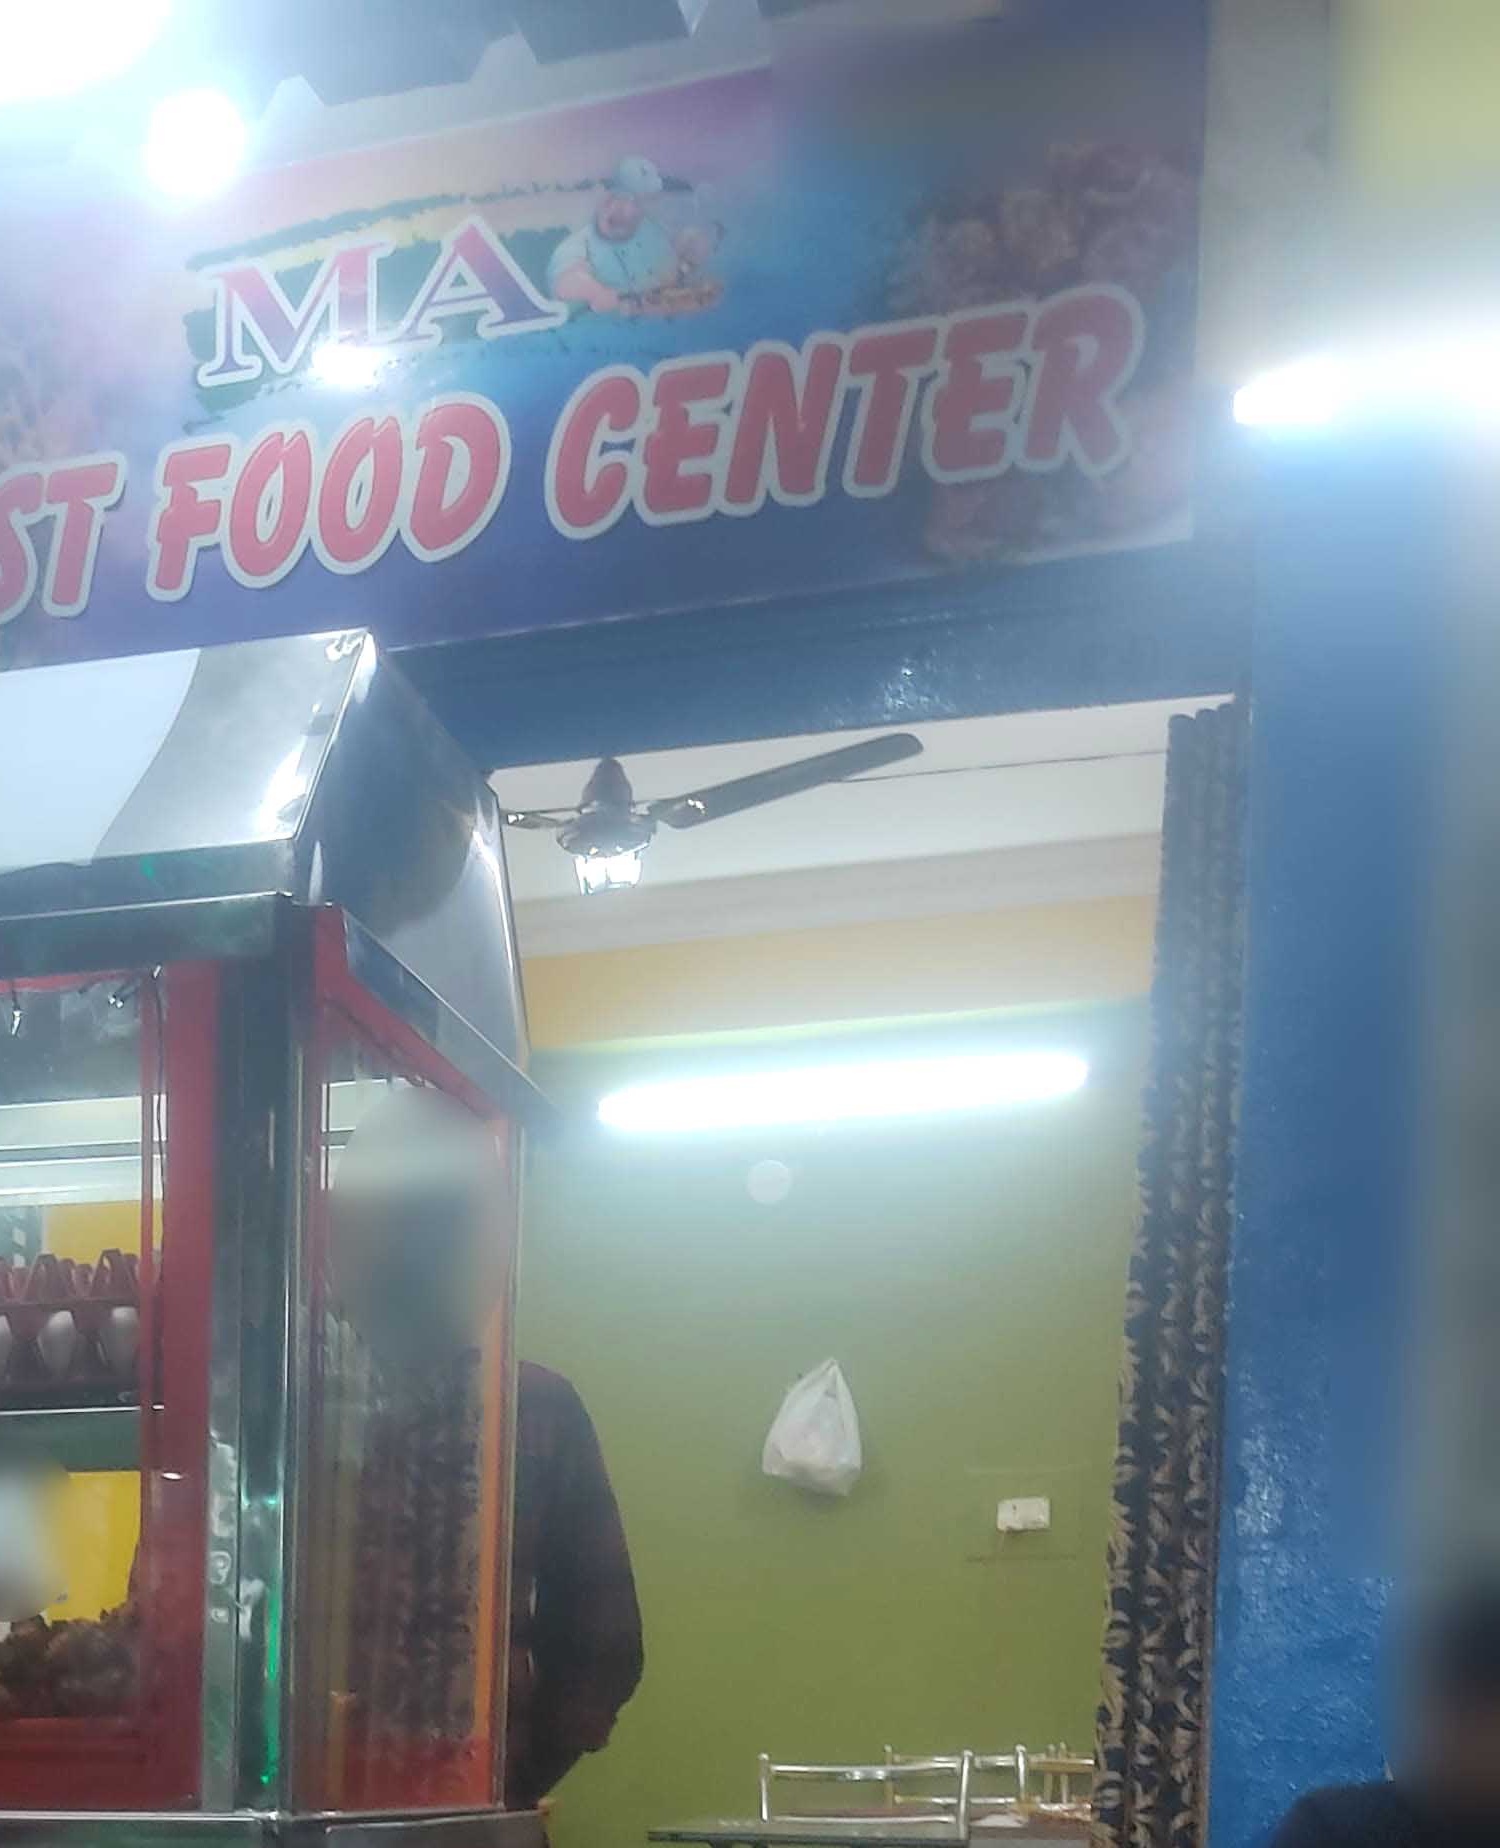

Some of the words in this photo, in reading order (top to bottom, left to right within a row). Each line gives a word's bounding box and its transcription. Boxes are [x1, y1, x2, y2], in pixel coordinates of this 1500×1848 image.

[200, 217, 566, 386] MA
[148, 393, 511, 603] FOOD
[546, 283, 1145, 539] CENTER
